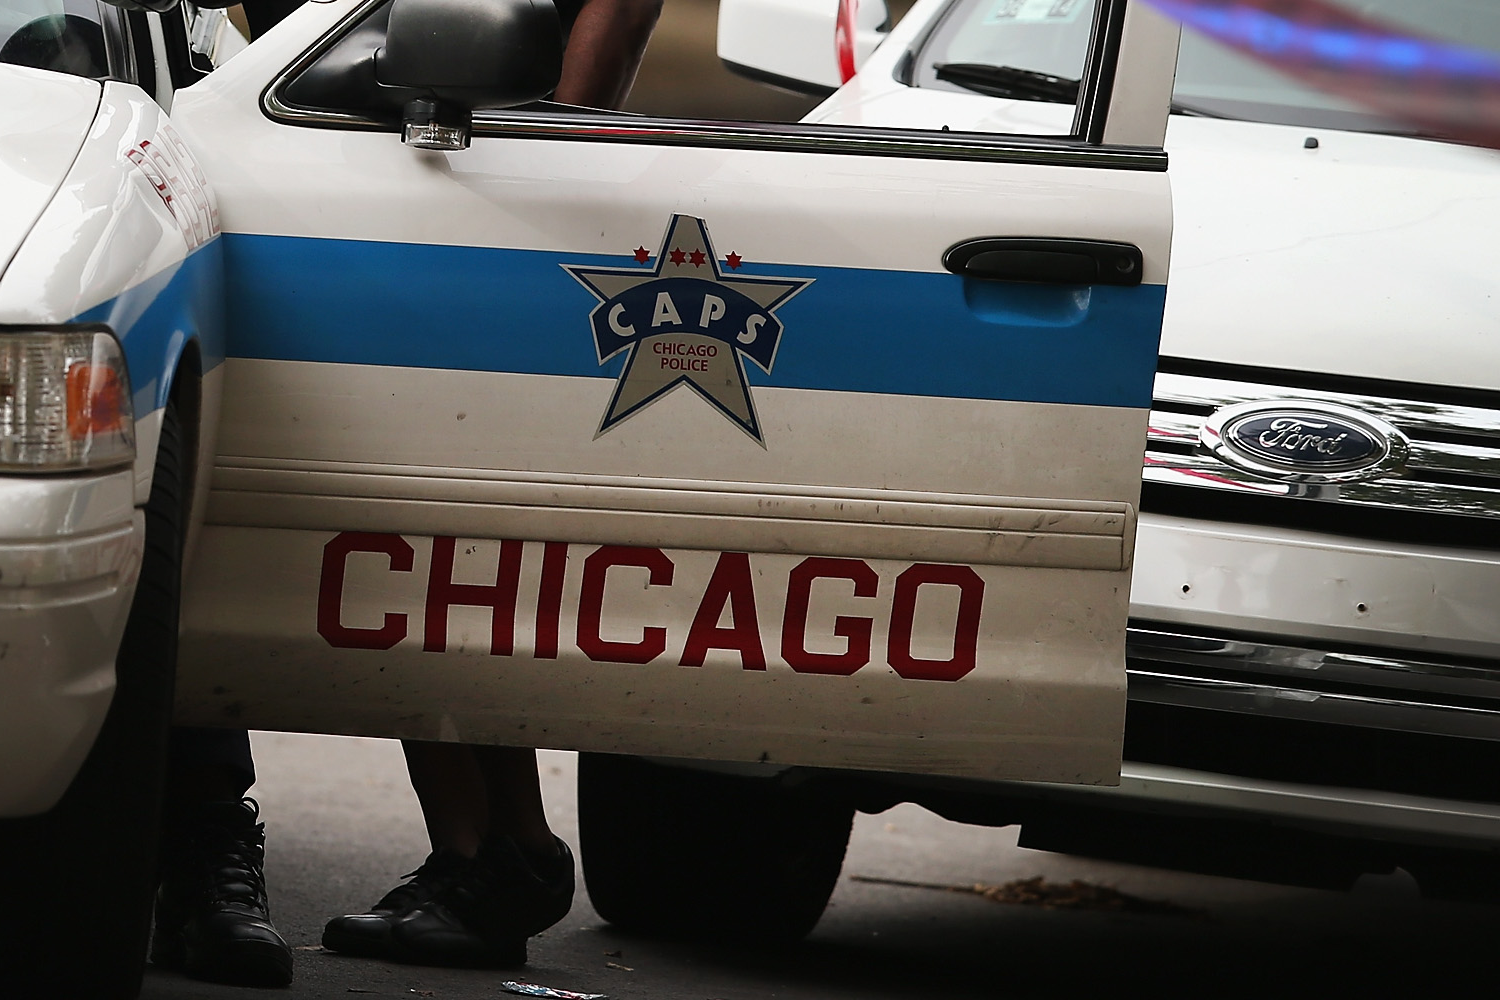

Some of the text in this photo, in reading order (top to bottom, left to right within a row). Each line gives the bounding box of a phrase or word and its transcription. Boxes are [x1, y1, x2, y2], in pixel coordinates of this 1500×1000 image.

[607, 291, 767, 345] CAPS
[652, 342, 718, 358] CHICAGO
[660, 357, 709, 372] POLICE
[1258, 417, 1348, 456] Ford
[316, 530, 986, 682] CHICAGO
